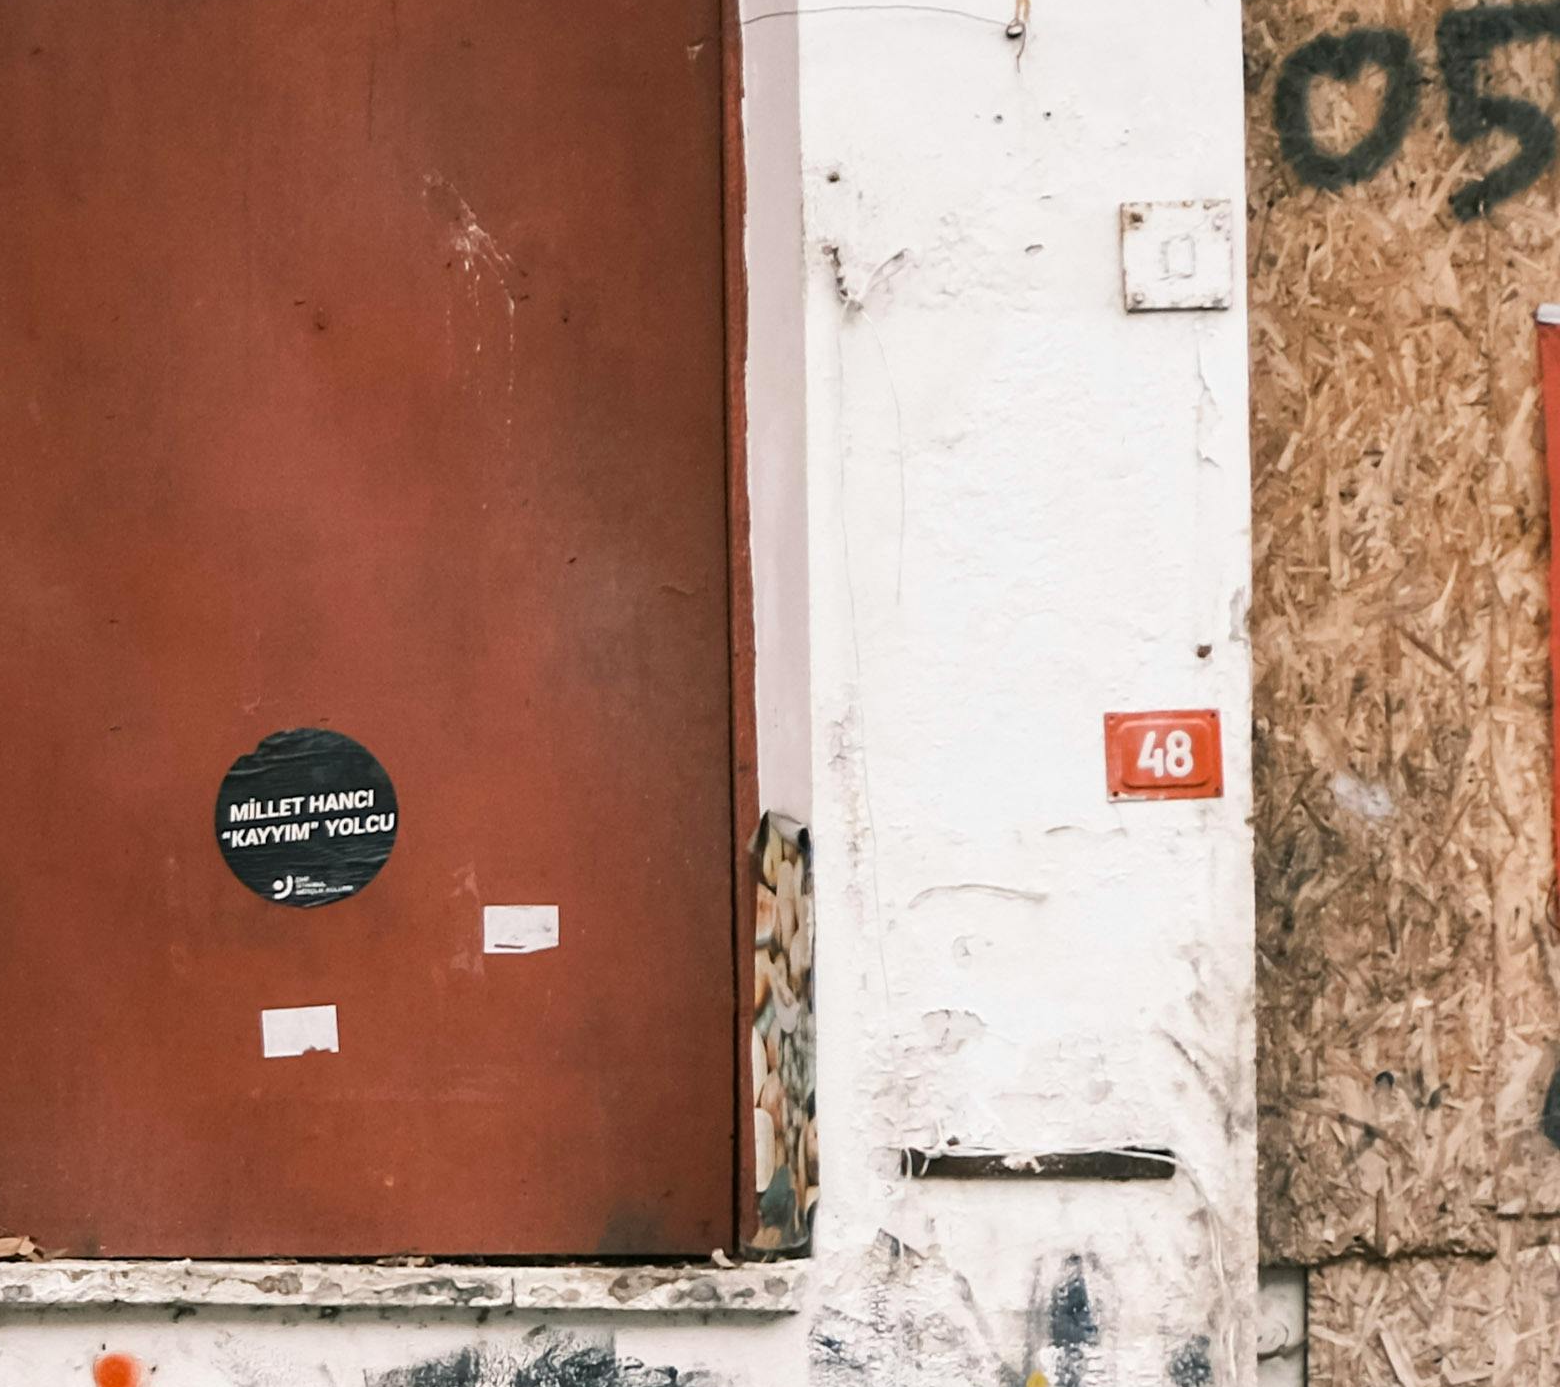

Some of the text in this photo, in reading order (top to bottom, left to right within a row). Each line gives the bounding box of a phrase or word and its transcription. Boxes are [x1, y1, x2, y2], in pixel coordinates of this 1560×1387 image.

[1137, 729, 1194, 779] 48
[230, 789, 375, 823] MİLLET HANCI
[325, 812, 395, 838] YOLCU
